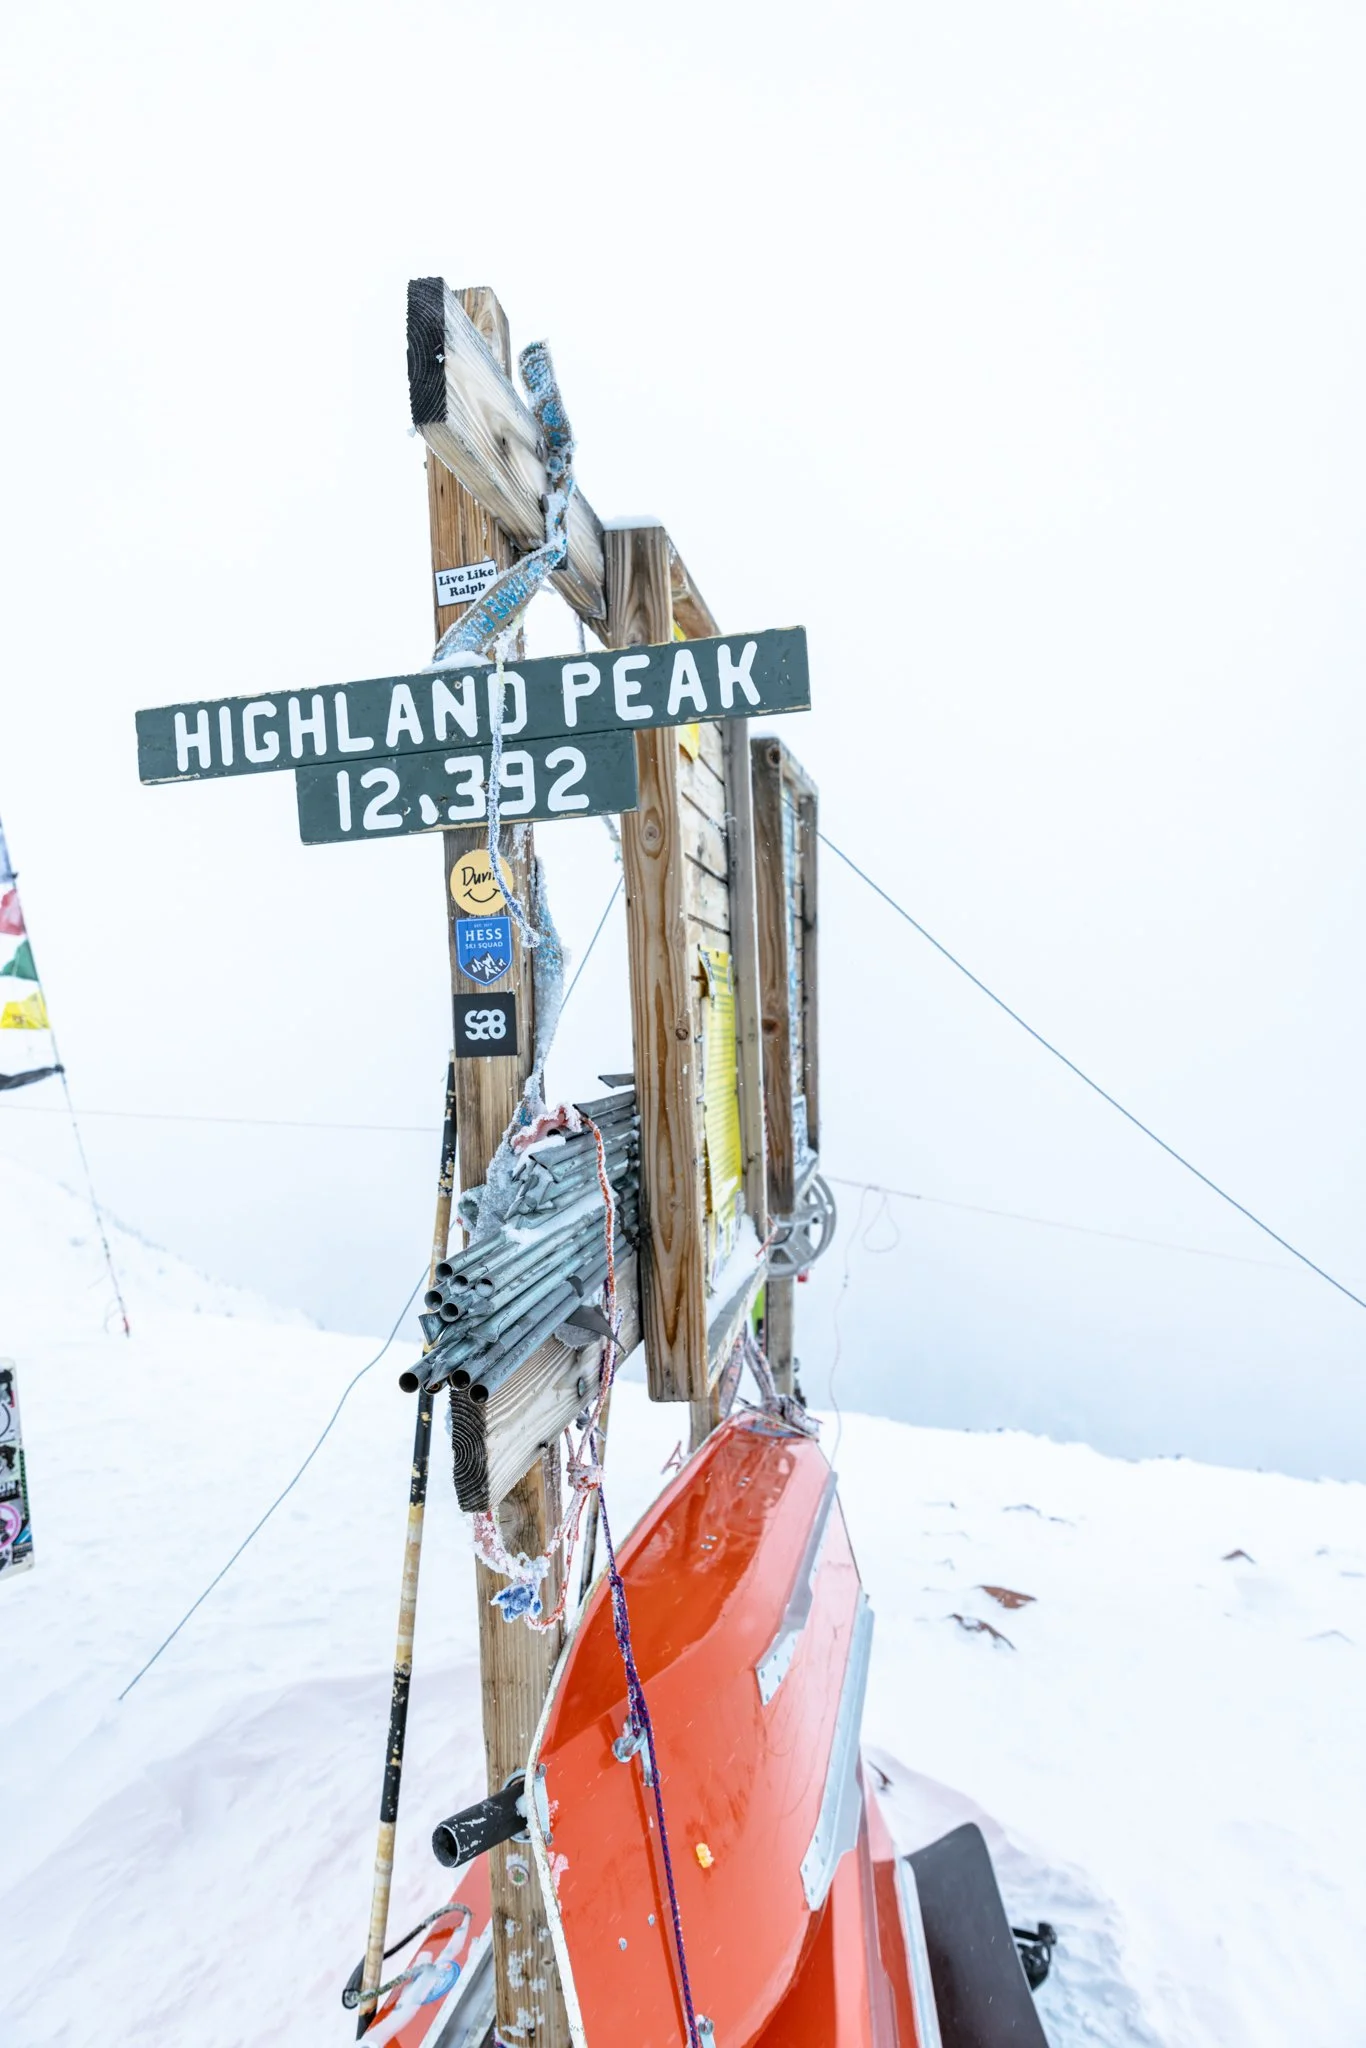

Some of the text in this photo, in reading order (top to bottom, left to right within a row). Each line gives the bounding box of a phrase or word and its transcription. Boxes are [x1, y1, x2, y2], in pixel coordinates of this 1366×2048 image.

[439, 568, 494, 586] Live Like
[450, 582, 486, 597] Ralph
[174, 641, 761, 772] HIGHLAND PEAK
[465, 928, 503, 941] HESS
[478, 941, 504, 949] SQUAD
